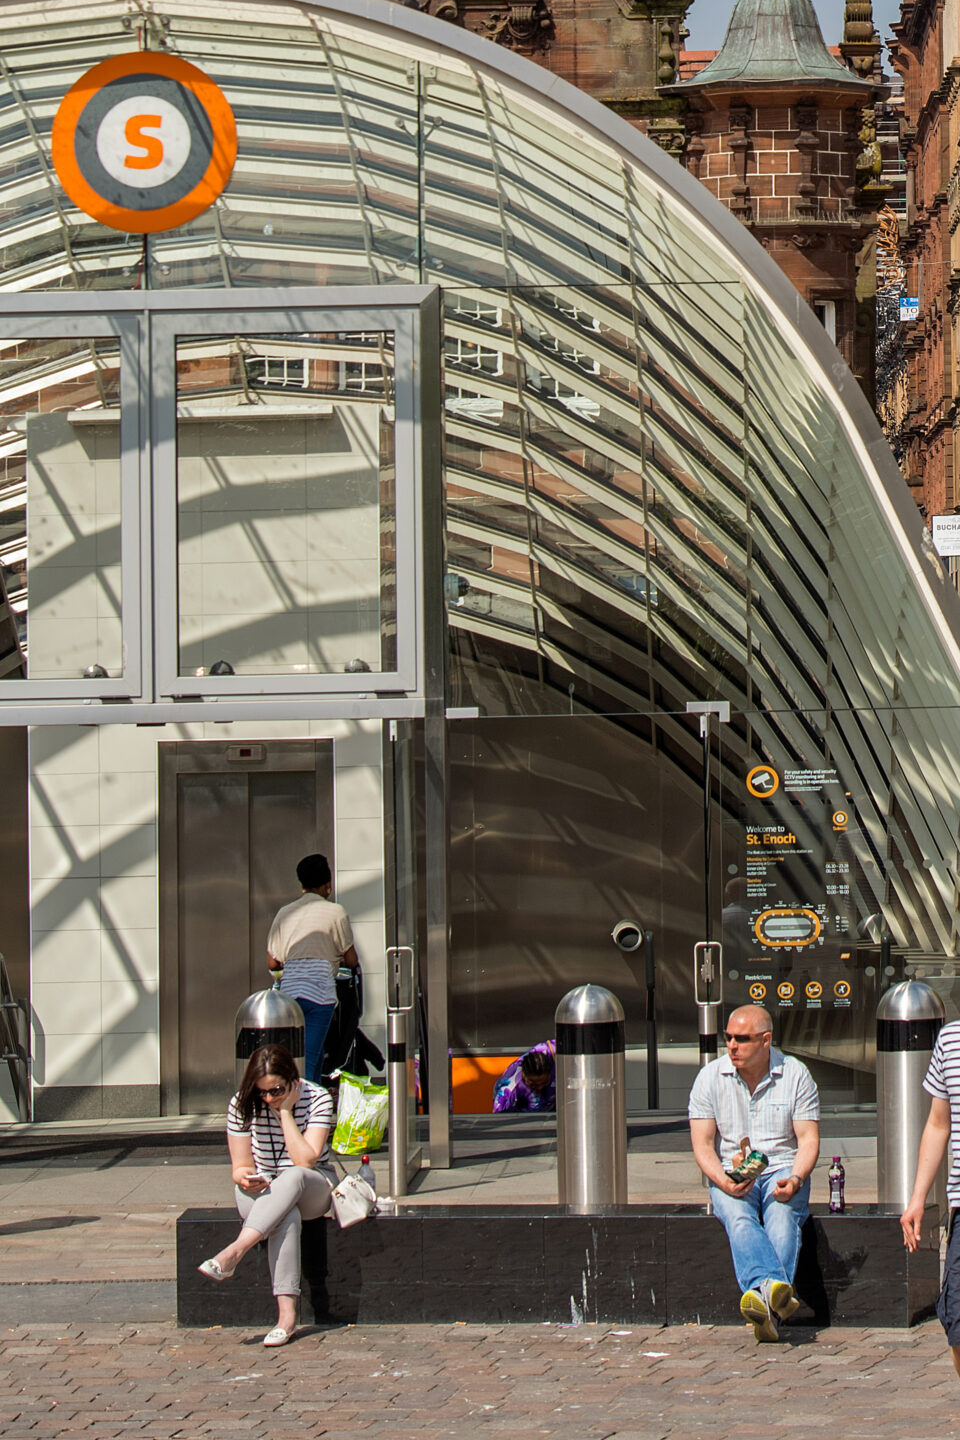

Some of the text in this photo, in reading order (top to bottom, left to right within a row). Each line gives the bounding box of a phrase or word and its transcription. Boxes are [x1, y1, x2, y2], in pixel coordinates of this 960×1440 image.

[123, 114, 164, 170] S
[746, 833, 796, 844] St. Enoch
